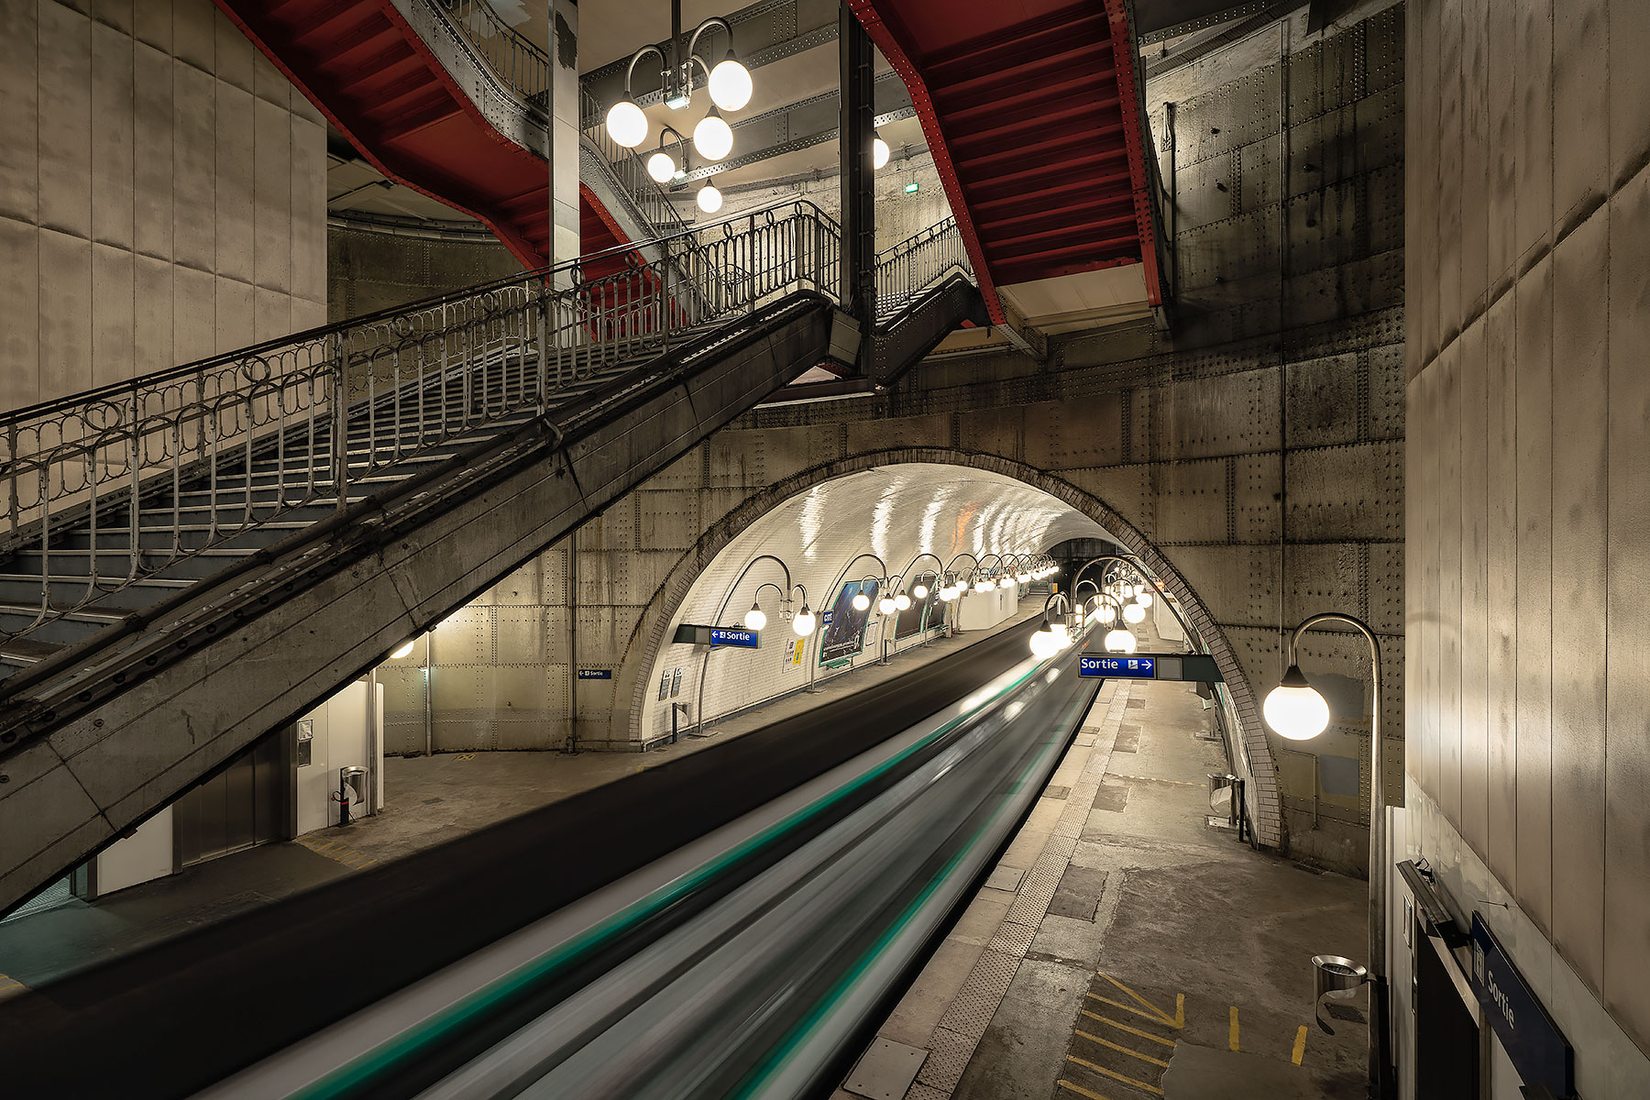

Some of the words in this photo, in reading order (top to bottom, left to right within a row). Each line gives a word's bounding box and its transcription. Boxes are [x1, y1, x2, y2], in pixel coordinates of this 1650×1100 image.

[726, 631, 750, 640] Sortie
[1081, 658, 1118, 669] Sortie
[1488, 970, 1514, 1029] Sortie
